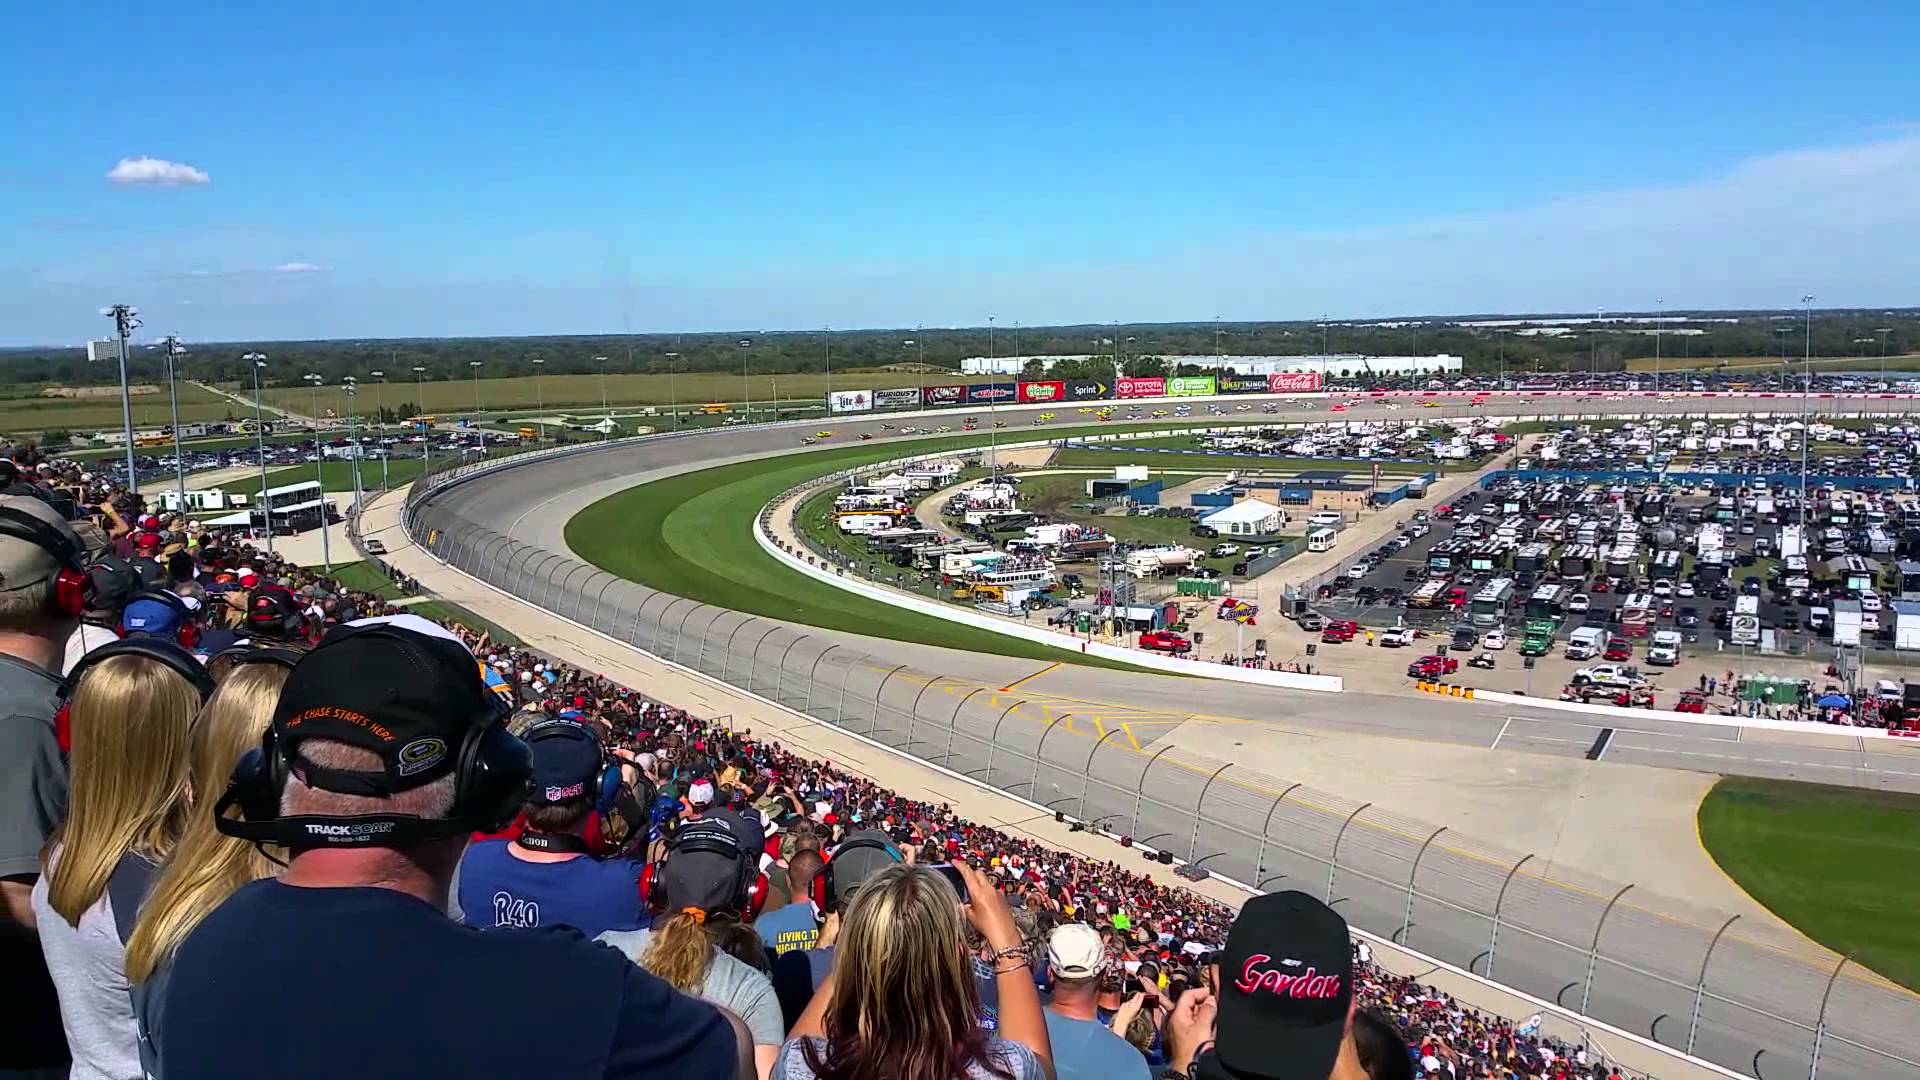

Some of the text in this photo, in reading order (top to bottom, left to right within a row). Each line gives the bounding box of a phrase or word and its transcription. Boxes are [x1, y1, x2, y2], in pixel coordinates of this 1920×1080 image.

[1075, 385, 1097, 396] Sprint
[838, 393, 853, 408] Lite
[1228, 606, 1259, 619] SUNOCO
[285, 707, 394, 743] THE CHASE STARTS HERE
[778, 931, 808, 943] LIVING
[1232, 953, 1342, 999] Gordon
